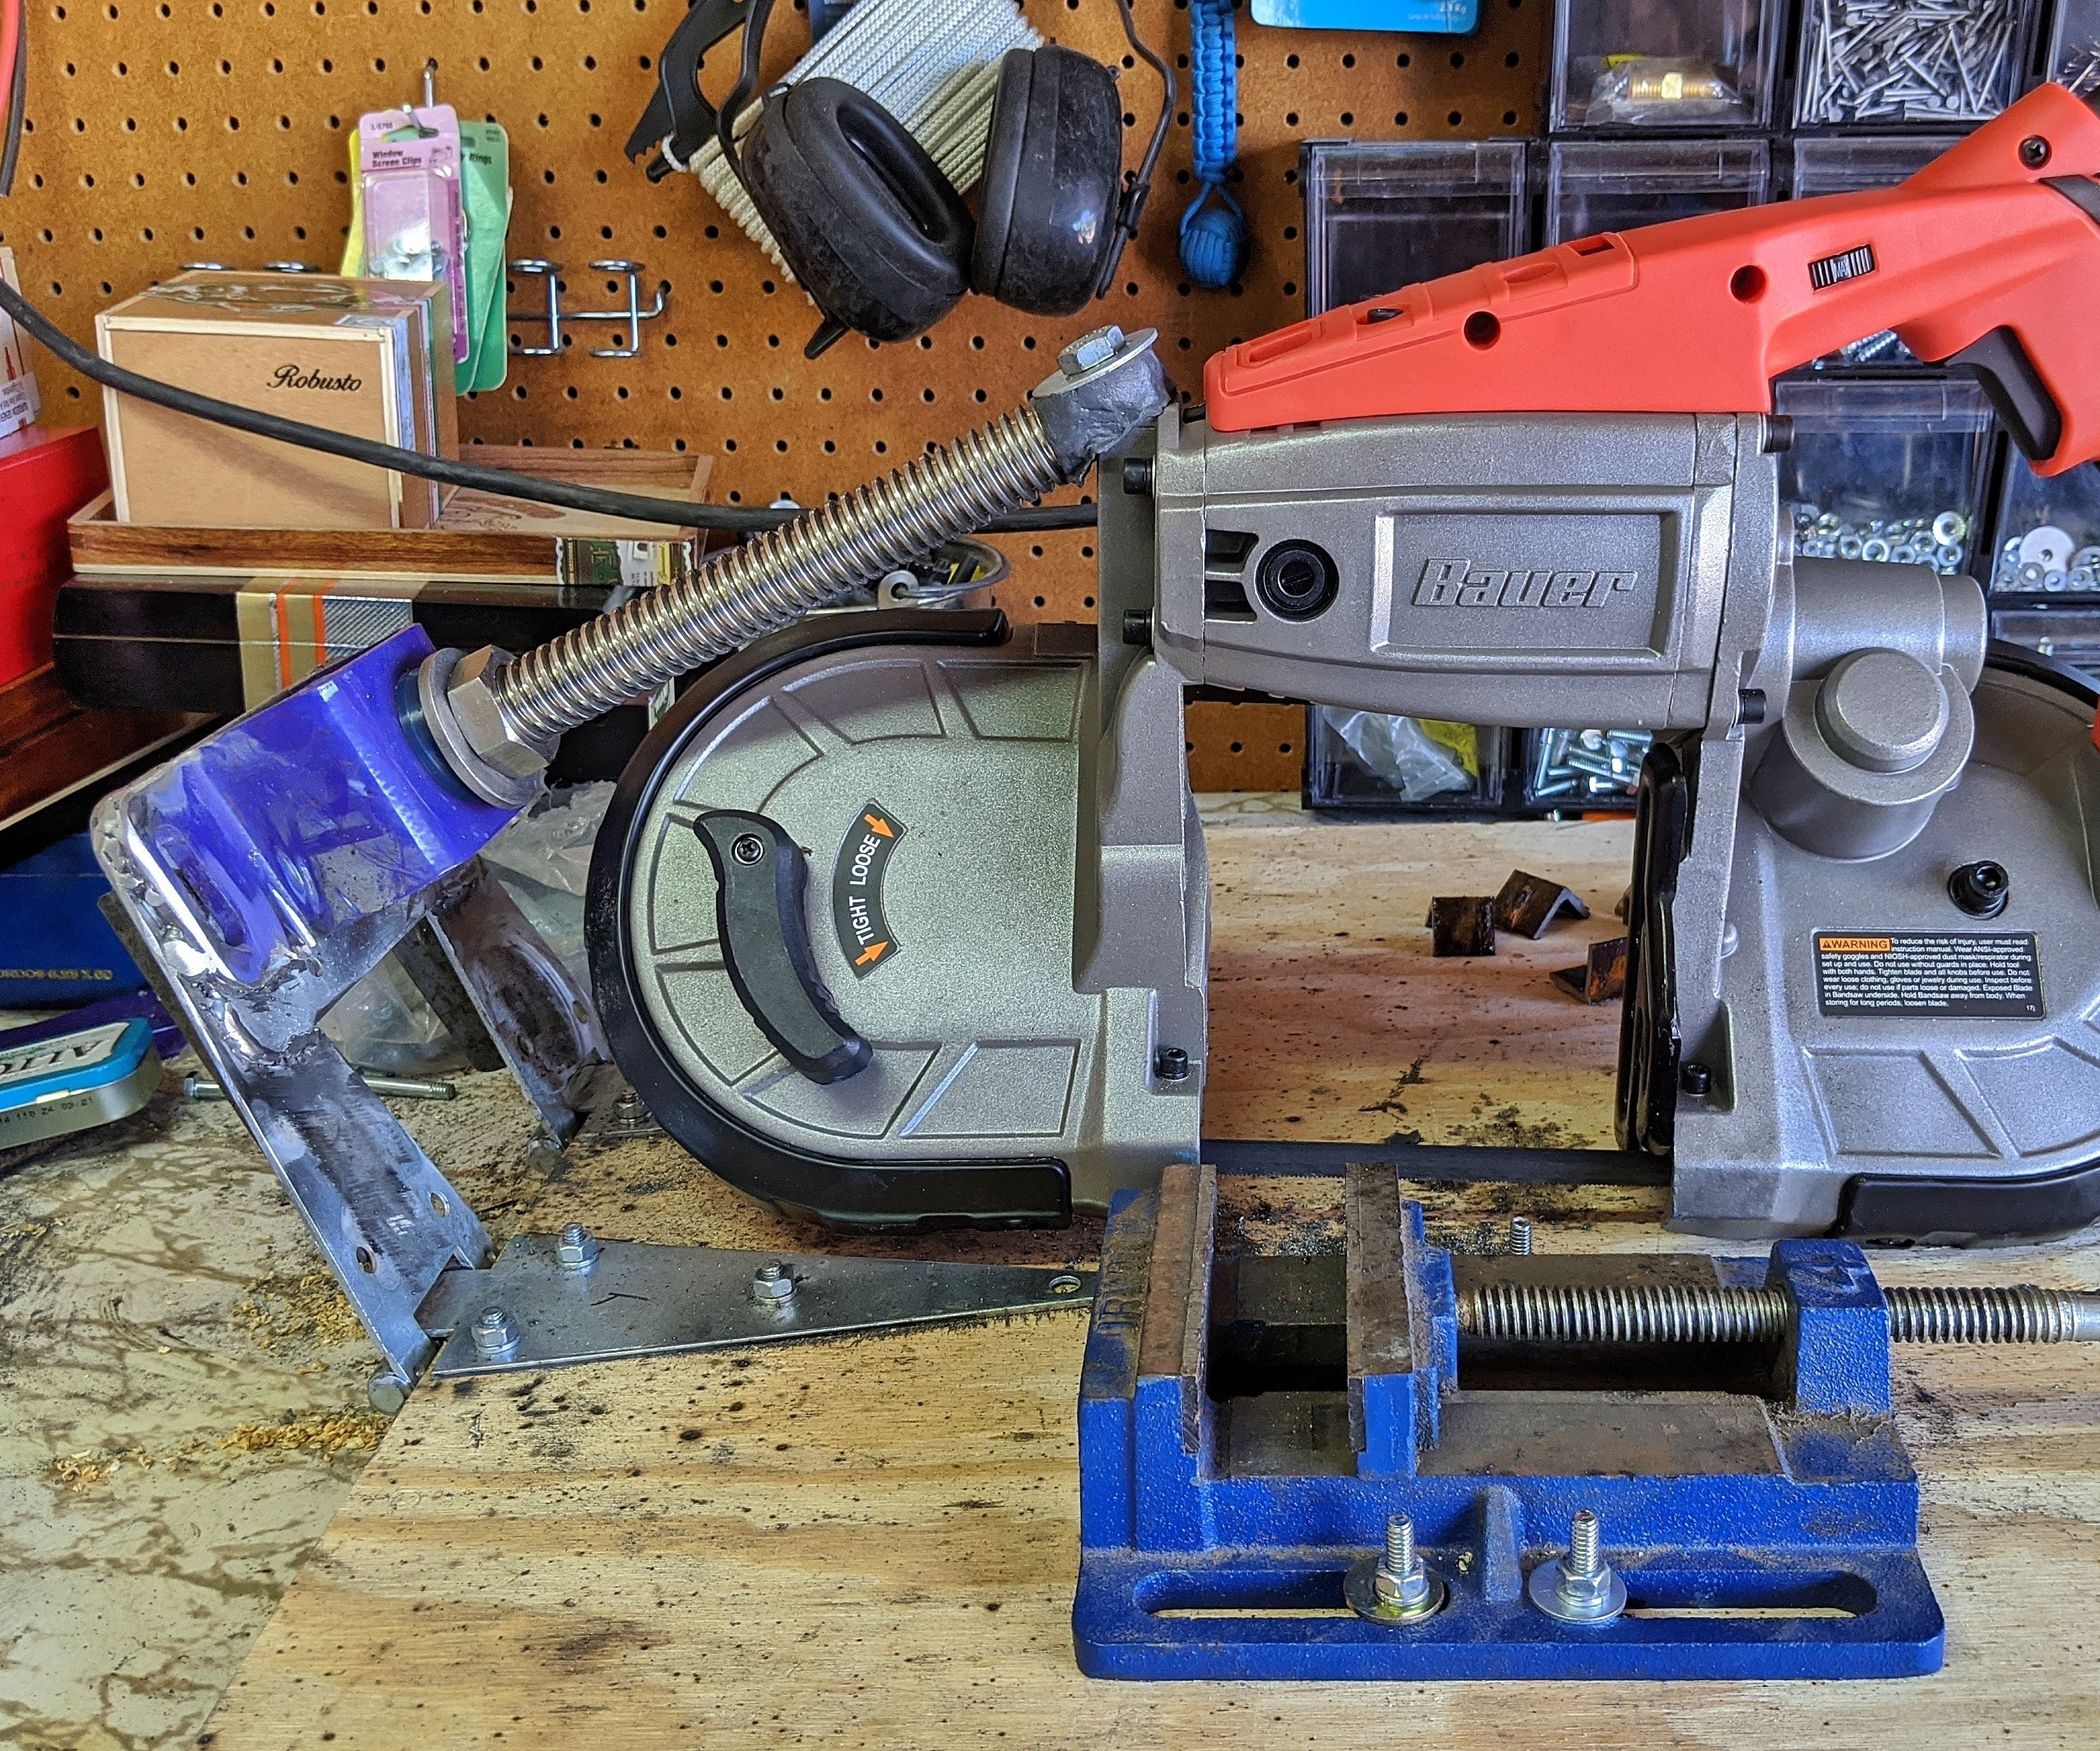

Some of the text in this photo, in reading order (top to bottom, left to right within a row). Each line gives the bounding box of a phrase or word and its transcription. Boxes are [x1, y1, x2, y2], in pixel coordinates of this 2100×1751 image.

[372, 150, 403, 159] Window
[372, 156, 422, 168] Screen Clips
[266, 364, 362, 391] Robusto
[1411, 558, 1638, 607] Bauer
[849, 834, 881, 945] TIGHT LOOSE
[1831, 940, 1888, 949] WARNING
